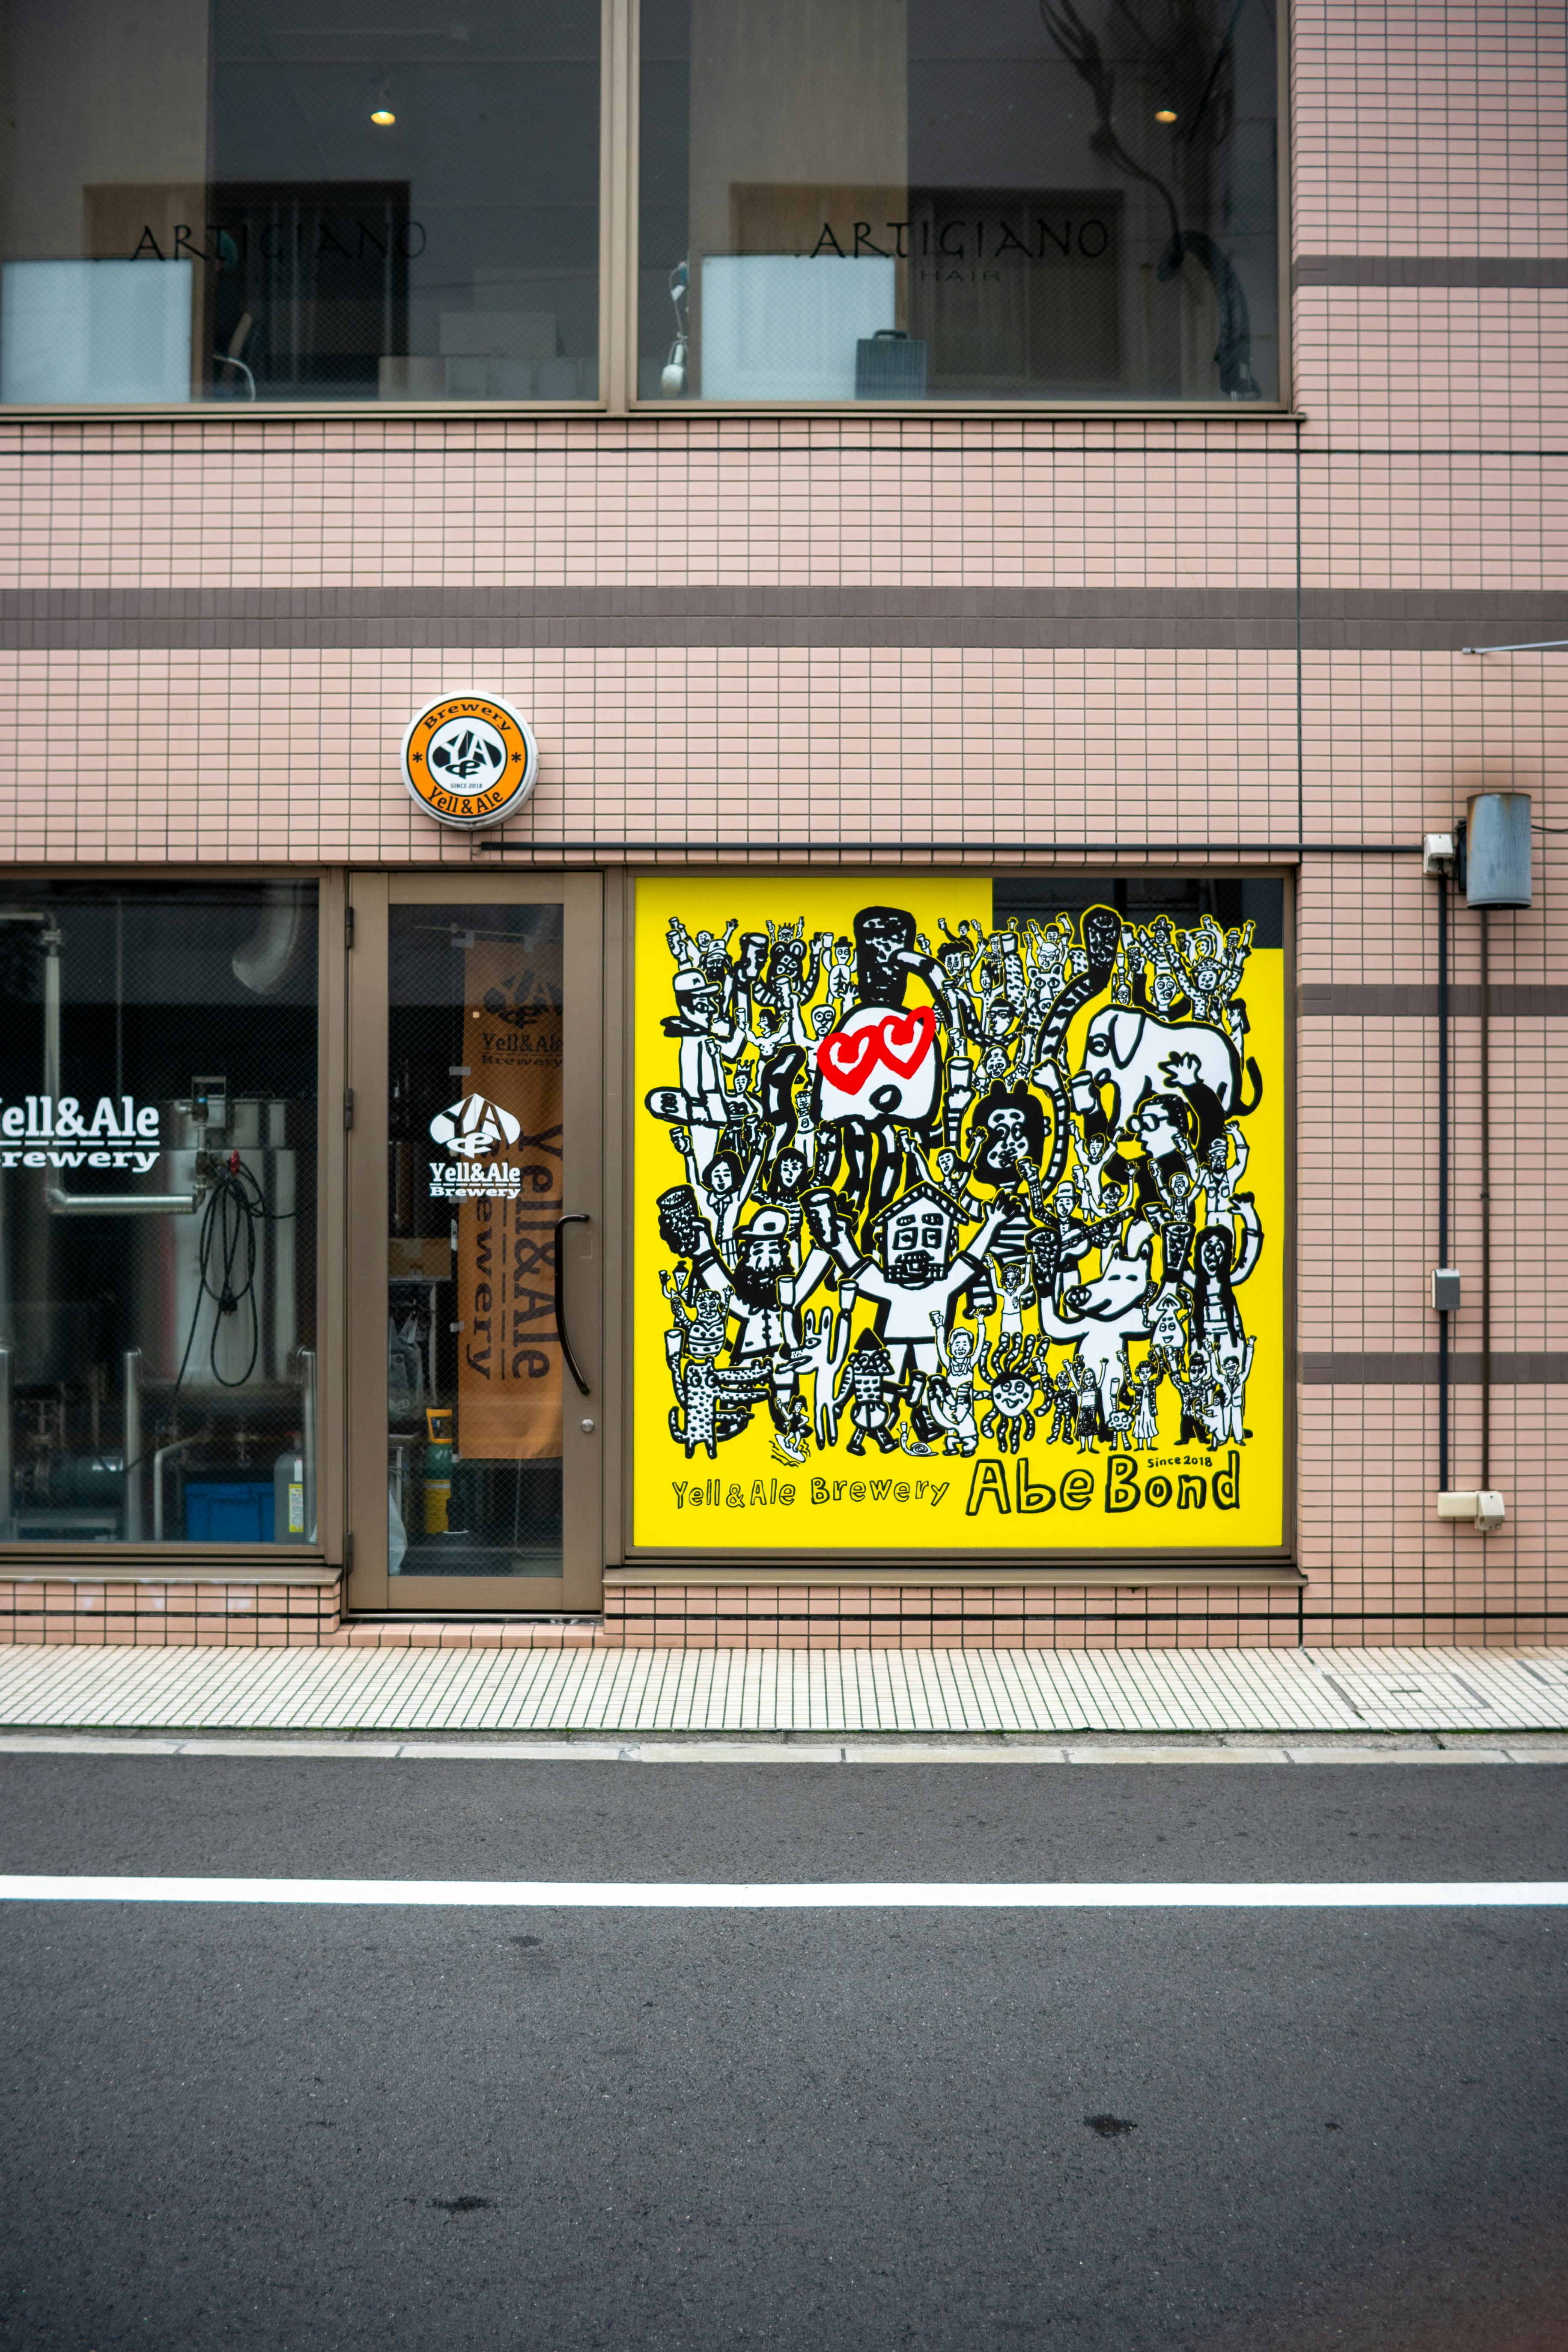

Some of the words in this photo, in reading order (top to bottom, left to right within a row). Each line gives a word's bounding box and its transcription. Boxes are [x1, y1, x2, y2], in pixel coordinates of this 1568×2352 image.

[129, 221, 426, 261] ARTIGIANO
[810, 219, 1107, 259] ARTIGIANO
[921, 270, 1001, 282] HAIR
[423, 704, 512, 730] Brewery
[427, 785, 503, 814] Yell&Ale
[482, 1055, 563, 1068] Brewery
[0, 1095, 160, 1138] ell&Ale
[0, 1151, 161, 1173] rewery
[429, 1162, 521, 1182] Yell&Ale
[429, 1186, 521, 1199] Brewery
[671, 1479, 796, 1509] Yell&Ale
[810, 1477, 950, 1507] Brewery
